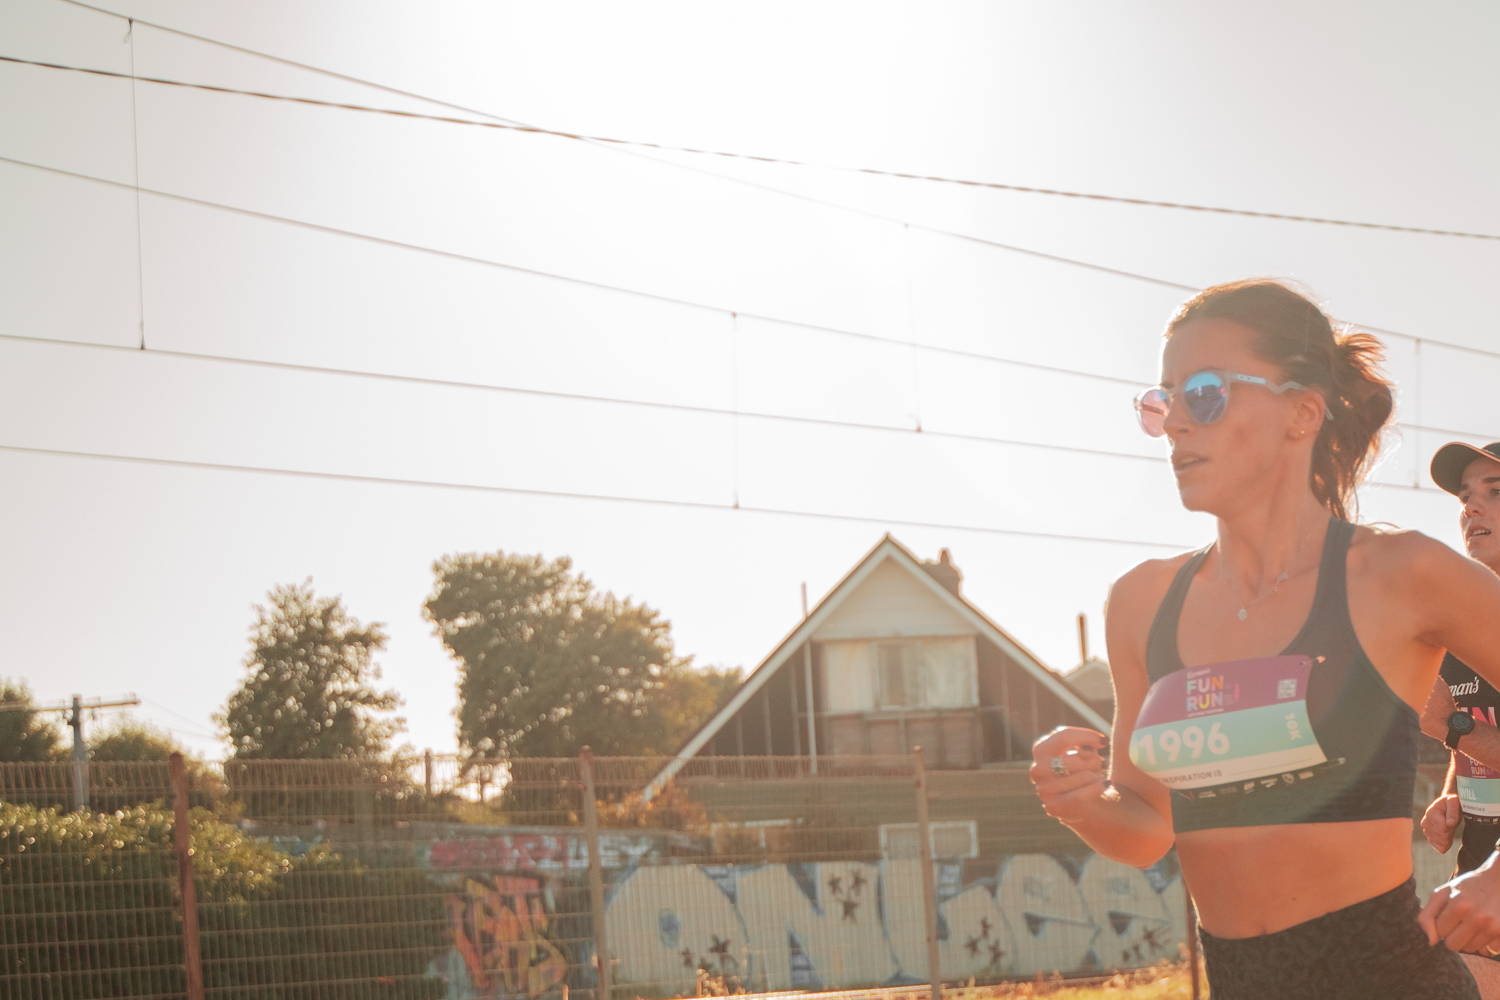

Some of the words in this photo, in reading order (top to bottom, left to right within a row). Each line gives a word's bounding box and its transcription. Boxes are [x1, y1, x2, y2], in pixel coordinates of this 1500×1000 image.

[1186, 674, 1225, 694] FUN
[1448, 676, 1480, 696] man's
[1186, 691, 1225, 712] RUN
[1284, 713, 1303, 741] 10K
[1137, 722, 1230, 765] 1996
